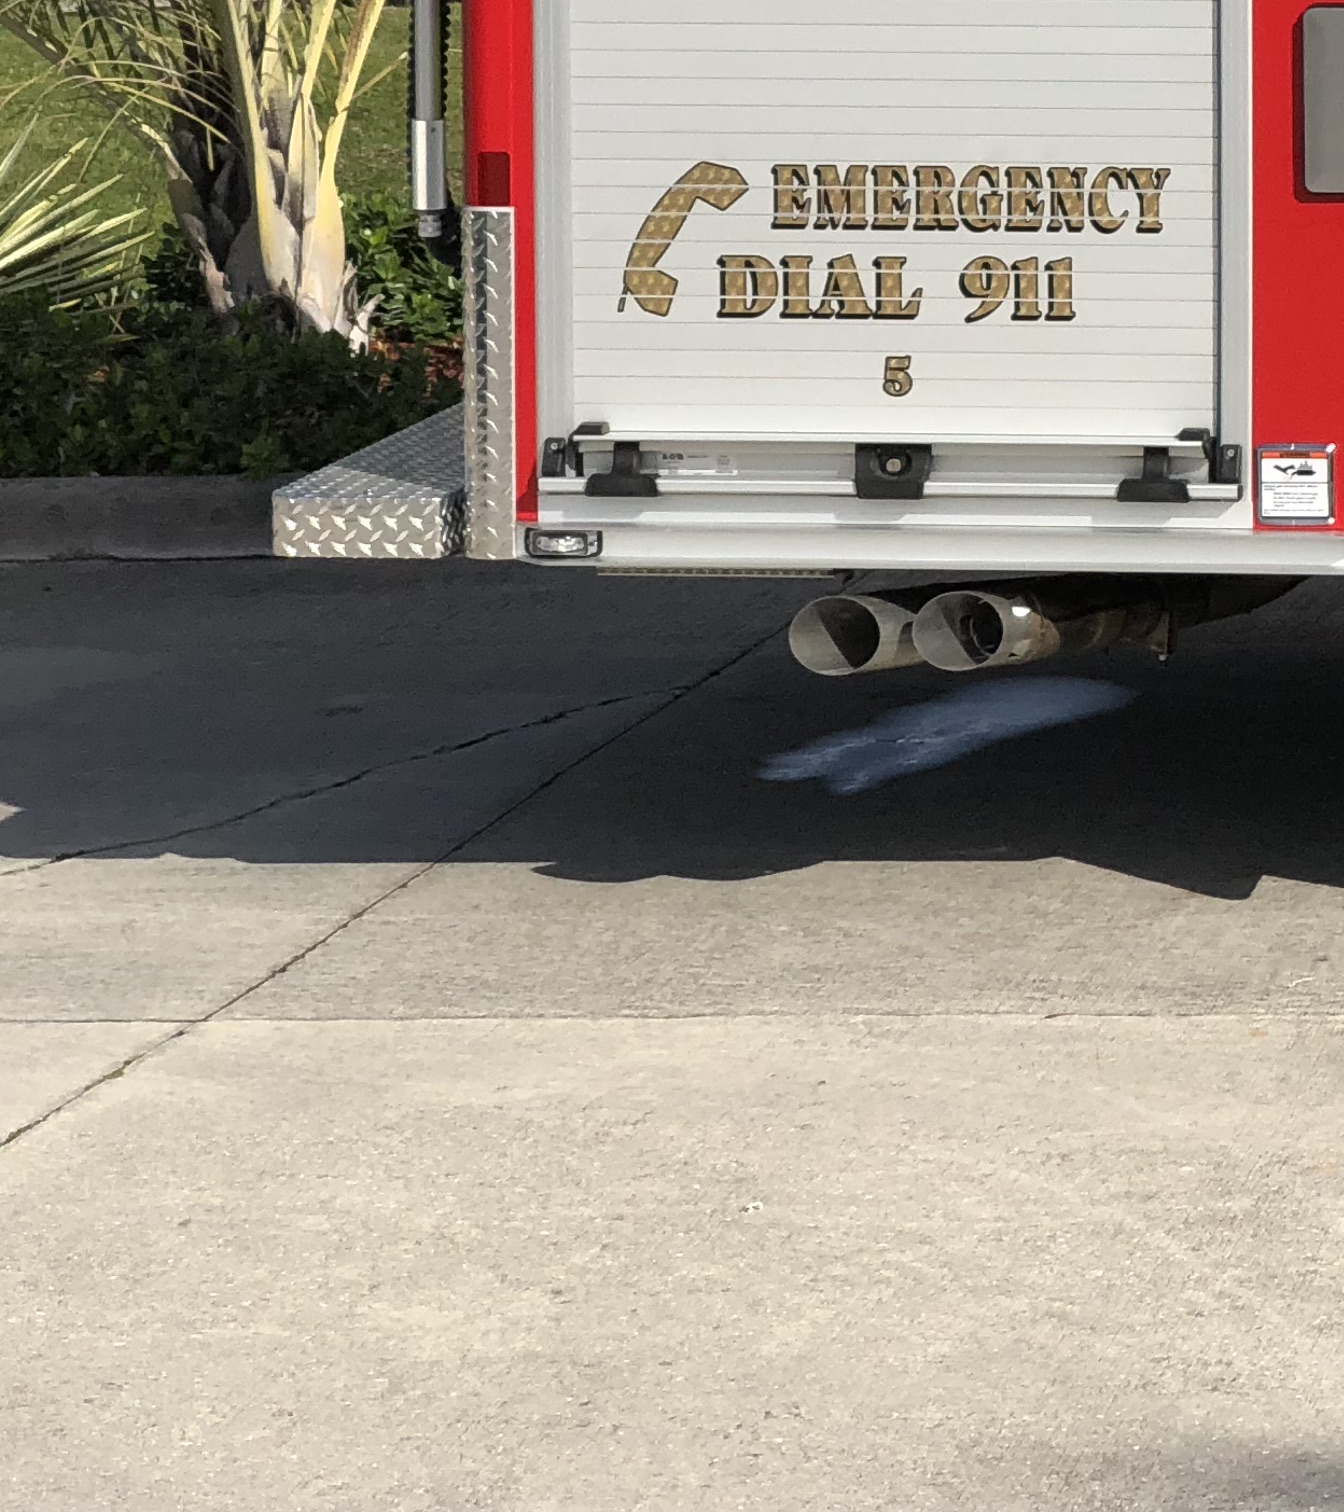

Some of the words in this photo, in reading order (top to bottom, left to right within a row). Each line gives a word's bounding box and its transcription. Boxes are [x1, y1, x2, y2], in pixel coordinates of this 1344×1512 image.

[770, 163, 1171, 234] EMERGENCY
[716, 253, 923, 320] DIAL
[958, 255, 1076, 323] 911
[882, 355, 913, 397] 5
